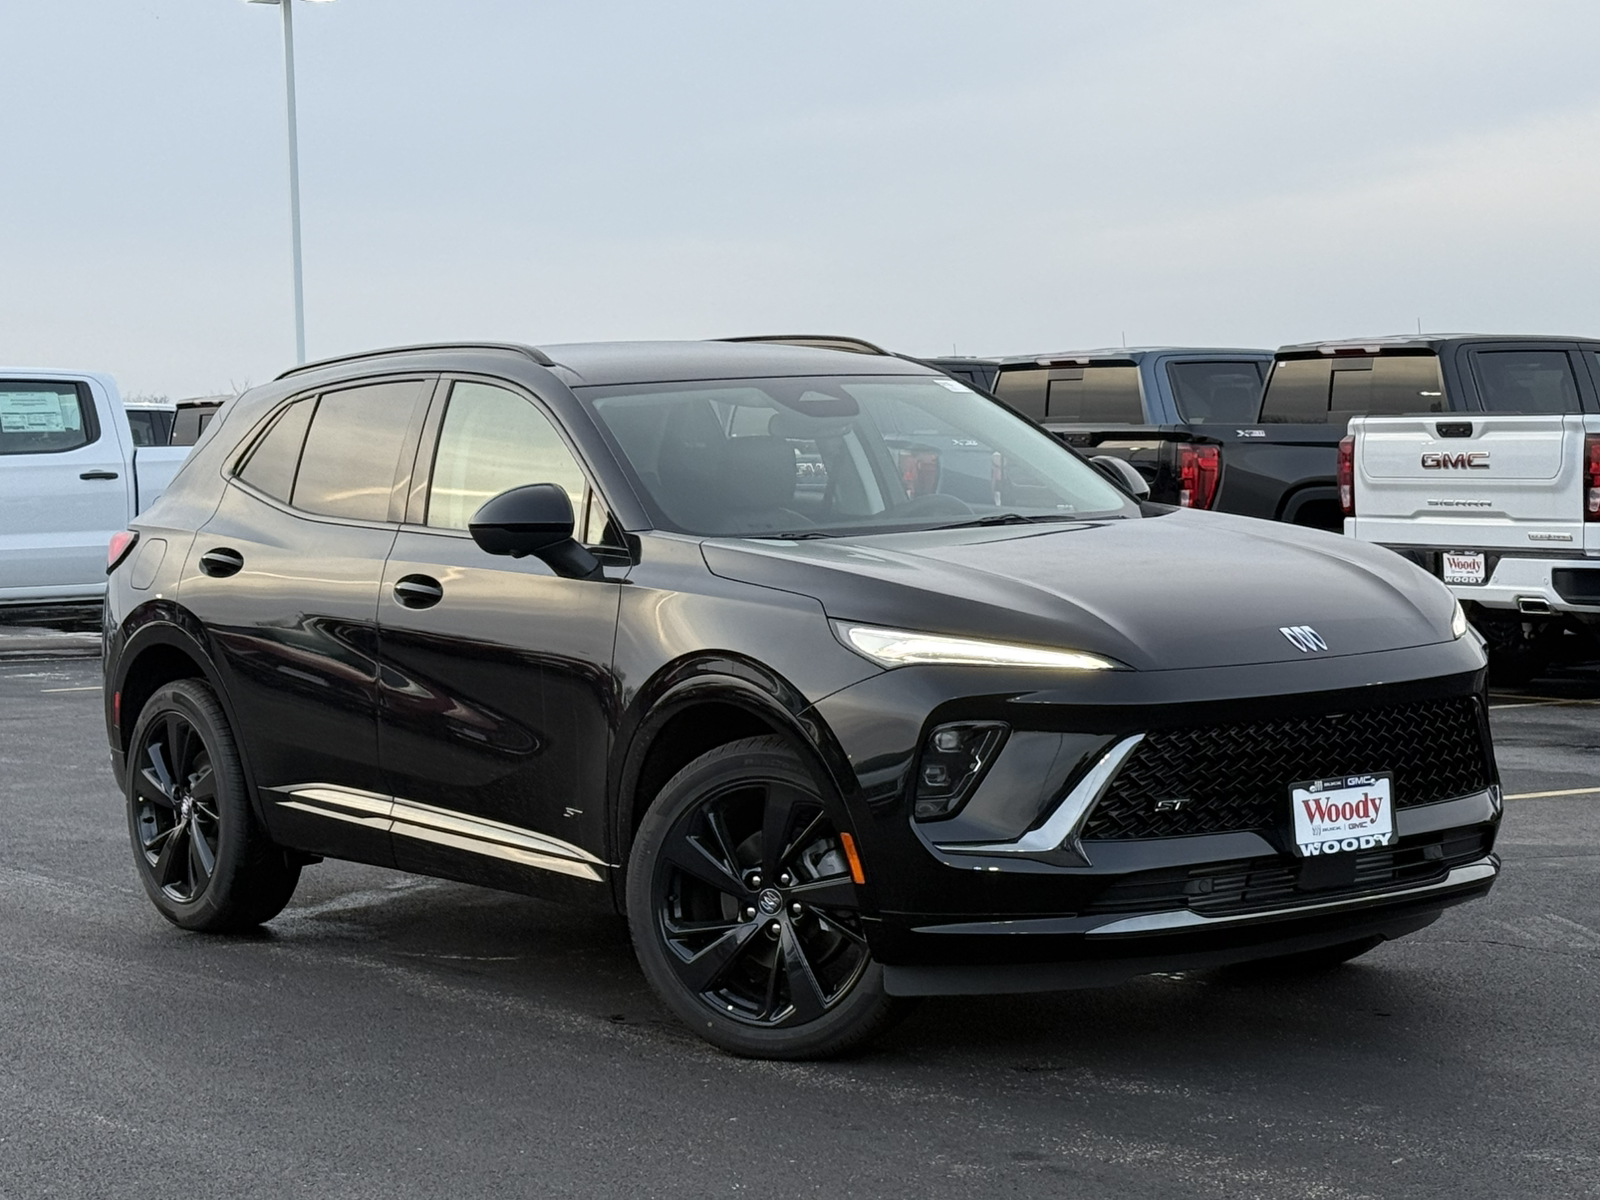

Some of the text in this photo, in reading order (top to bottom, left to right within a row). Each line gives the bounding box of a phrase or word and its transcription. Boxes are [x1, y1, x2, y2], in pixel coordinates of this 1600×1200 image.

[1421, 451, 1491, 470] GMC
[1427, 499, 1493, 508] SIERRA
[1446, 557, 1483, 573] Woody
[1444, 575, 1484, 584] WOODY
[1347, 775, 1372, 786] GMC
[1301, 792, 1383, 825] Woody
[1348, 821, 1368, 830] GMC
[1299, 833, 1393, 857] WOODY
